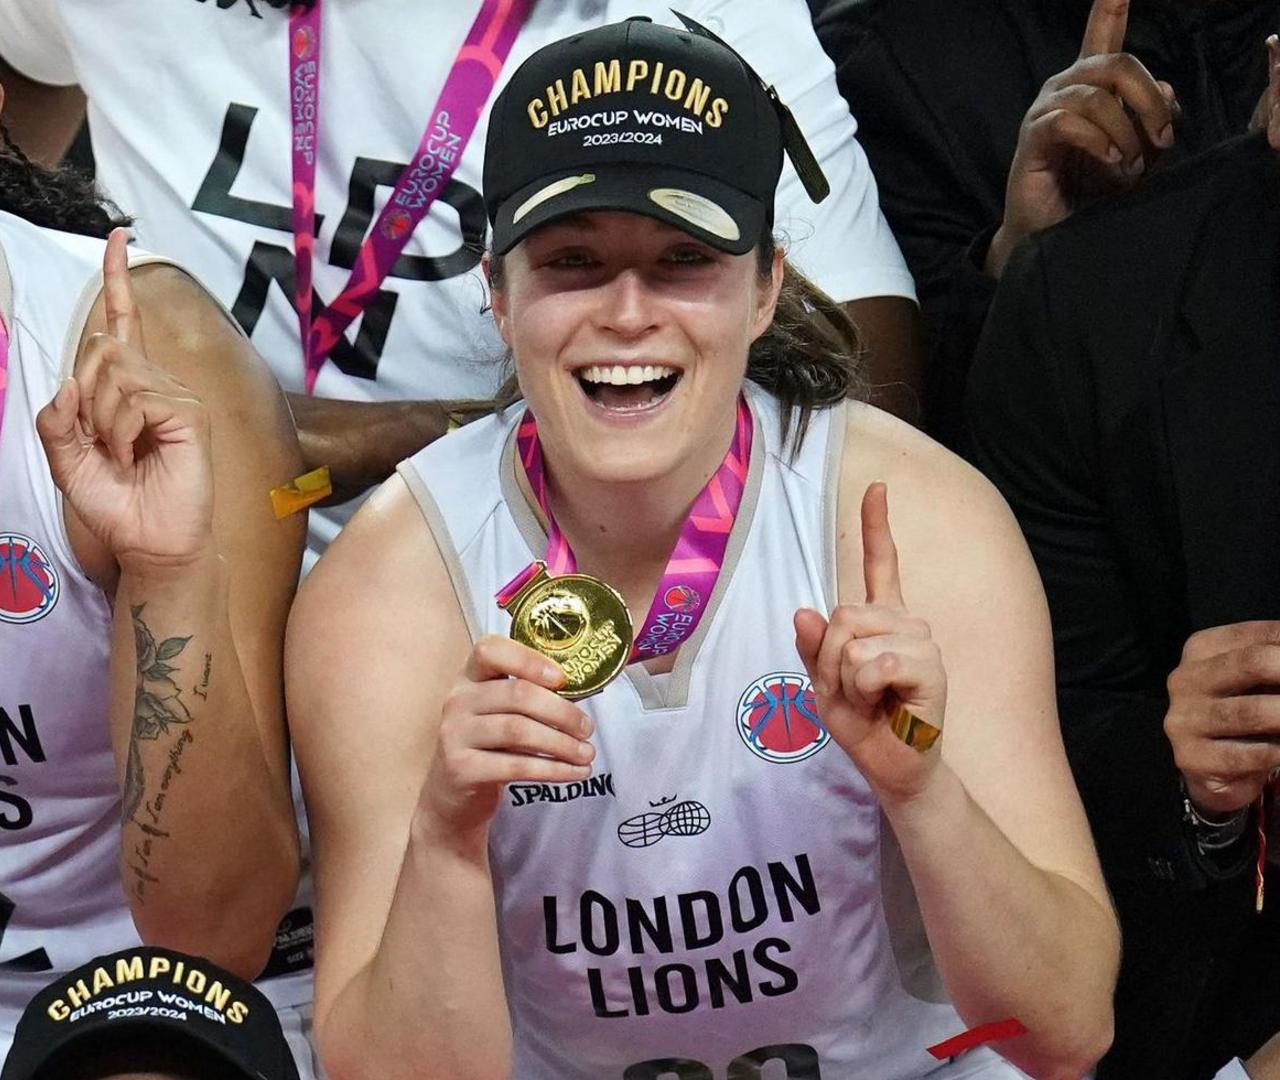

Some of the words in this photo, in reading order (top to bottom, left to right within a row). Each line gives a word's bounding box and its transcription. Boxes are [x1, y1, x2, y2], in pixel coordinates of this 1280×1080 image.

[526, 59, 729, 130] CHAMPIONS
[548, 115, 627, 137] EUROCUP
[633, 110, 703, 135] WOMEN
[394, 111, 452, 206] EUROCUP
[408, 133, 463, 210] WOMEN
[583, 133, 662, 147] 2023/2024
[562, 619, 614, 674] UROCUP
[543, 853, 821, 956] LONDON
[47, 957, 249, 1024] CHAMPIONS
[69, 991, 153, 1022] EUROCUP
[157, 990, 226, 1024] WOMEN
[587, 938, 798, 1018] LIONS
[107, 1006, 187, 1021] 2023/2024
